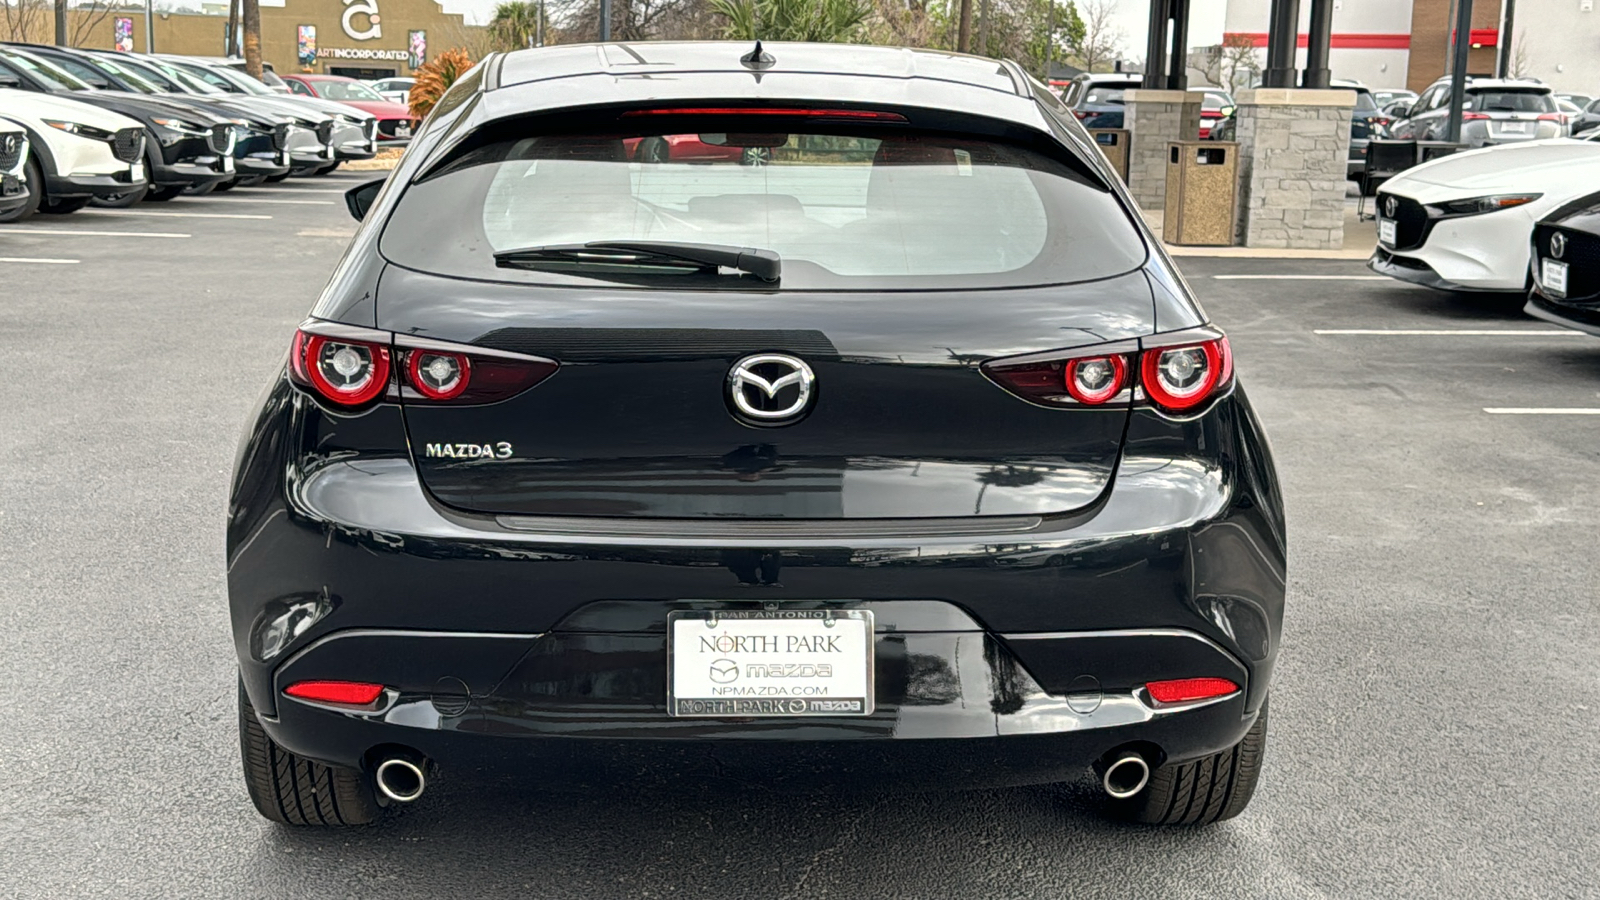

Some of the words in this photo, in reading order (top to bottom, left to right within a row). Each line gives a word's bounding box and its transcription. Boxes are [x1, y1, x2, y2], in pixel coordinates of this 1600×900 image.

[754, 611, 825, 619] ANTONIO
[699, 635, 778, 654] NORTH
[786, 635, 842, 653] PARK
[746, 664, 833, 678] mazda
[712, 686, 828, 696] NPMAZDA.COM
[680, 700, 738, 713] NORTH
[742, 700, 785, 713] PARK
[810, 701, 861, 711] mazda
